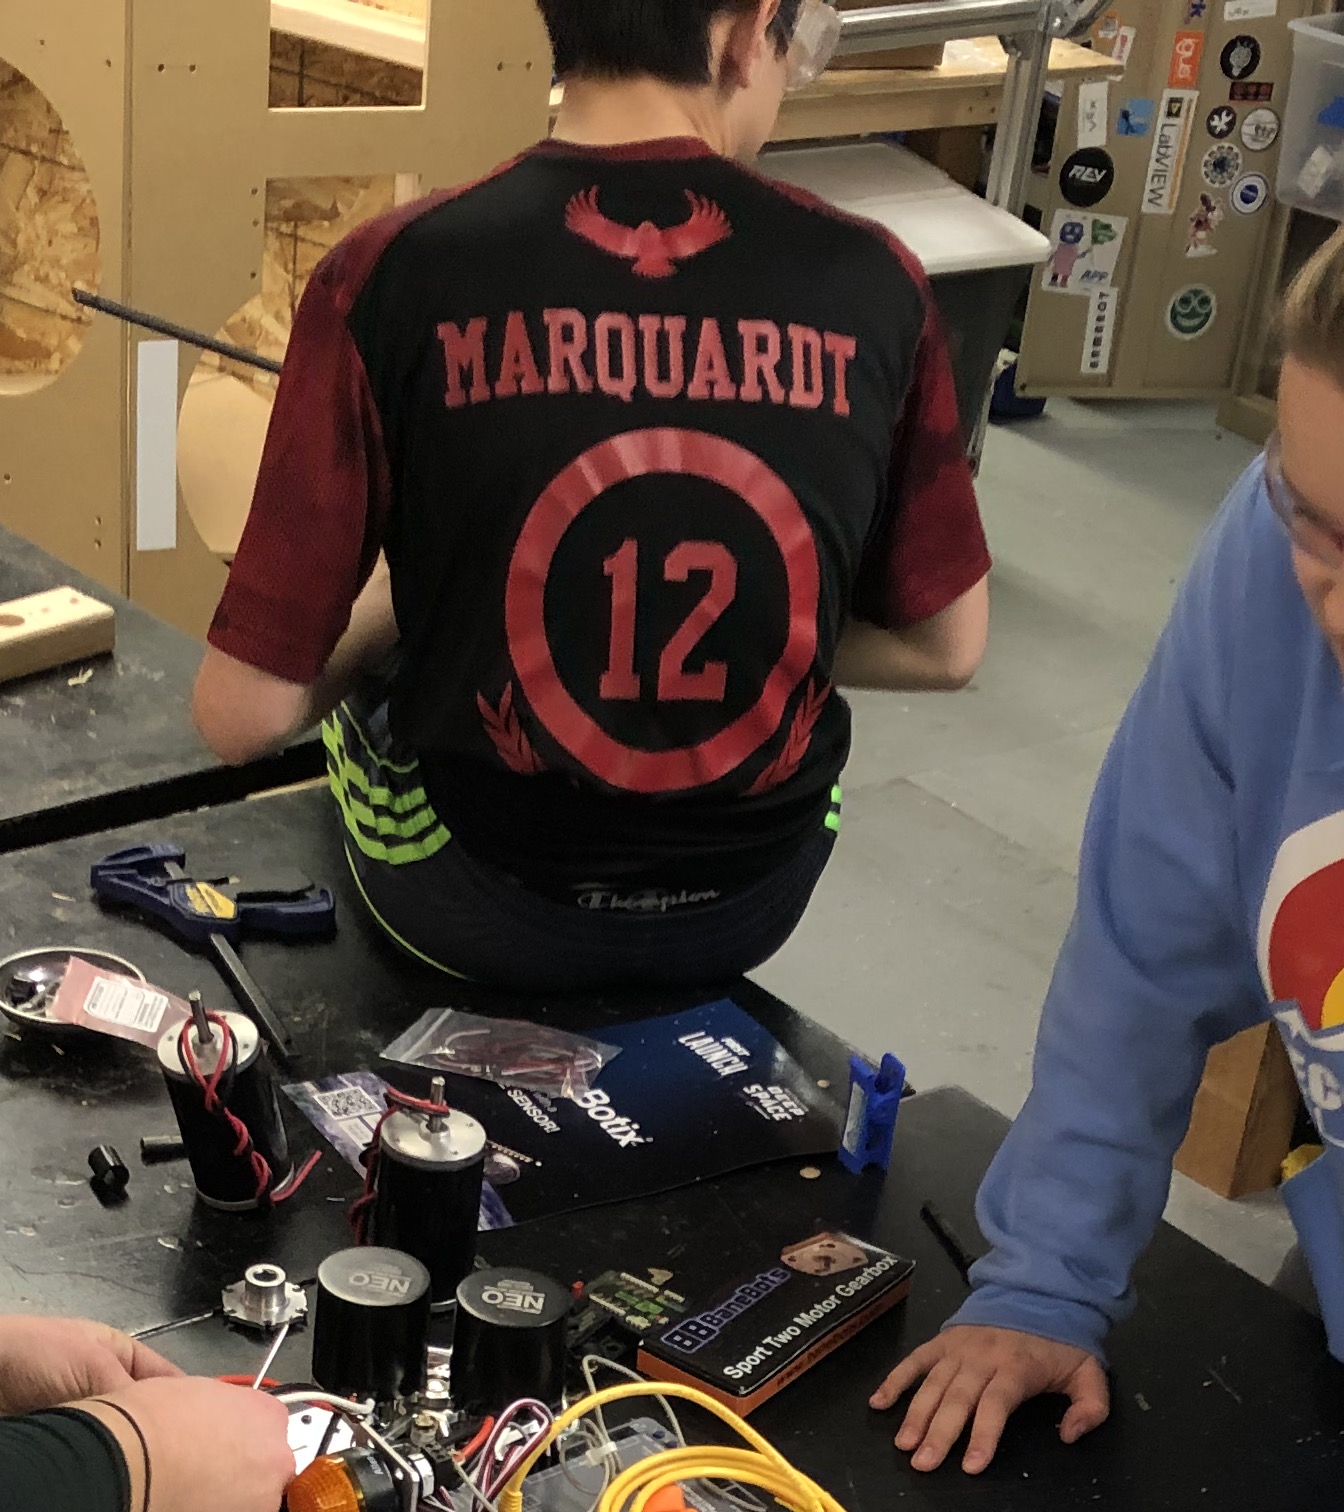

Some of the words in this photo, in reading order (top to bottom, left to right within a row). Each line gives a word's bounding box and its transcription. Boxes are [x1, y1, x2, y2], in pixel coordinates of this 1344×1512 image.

[1068, 164, 1106, 183] REV
[1147, 121, 1178, 207] LabVIEW
[437, 307, 857, 417] MARQUARDT
[599, 537, 738, 701] 12
[678, 1031, 749, 1077] LAUNCH
[742, 1083, 793, 1121] SPACE
[767, 1085, 806, 1116] DEEP
[481, 1288, 546, 1312] NEO
[723, 1344, 772, 1380] Sport
[762, 1324, 801, 1349] Two
[792, 1292, 841, 1328] Motor
[835, 1254, 899, 1298] Gearbox
